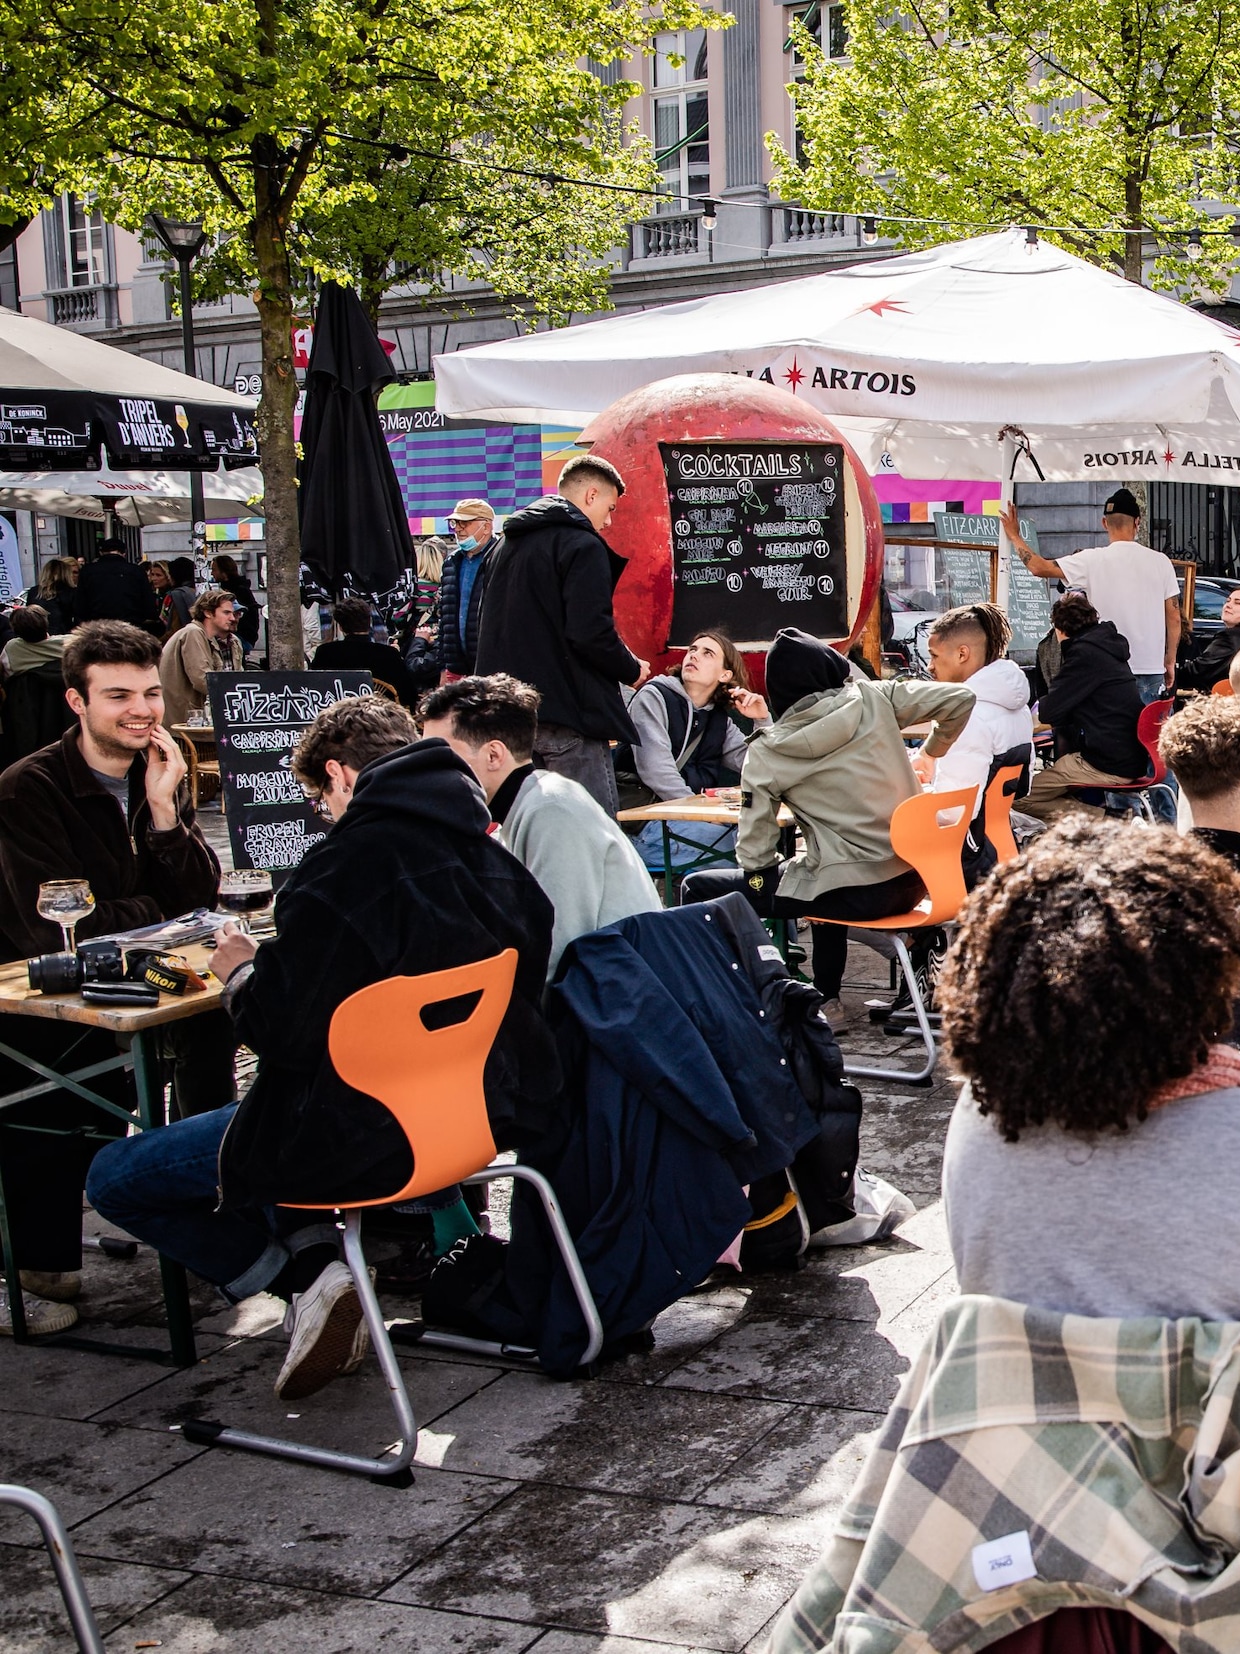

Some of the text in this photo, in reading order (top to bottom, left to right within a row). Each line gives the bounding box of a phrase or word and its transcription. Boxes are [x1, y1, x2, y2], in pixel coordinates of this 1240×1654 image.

[811, 366, 917, 396] ARTOIS
[17, 409, 44, 418] KONINCK
[118, 399, 163, 424] TRIPEL
[388, 413, 413, 433] May
[414, 411, 445, 429] 2021
[117, 421, 176, 448] D'ANVERS
[678, 453, 802, 477] COCKTAILS
[97, 480, 153, 492] Duvel
[236, 770, 296, 789] MOSCOW
[253, 784, 304, 803] MULE
[247, 819, 305, 841] FROZEN
[145, 968, 178, 990] Nikon
